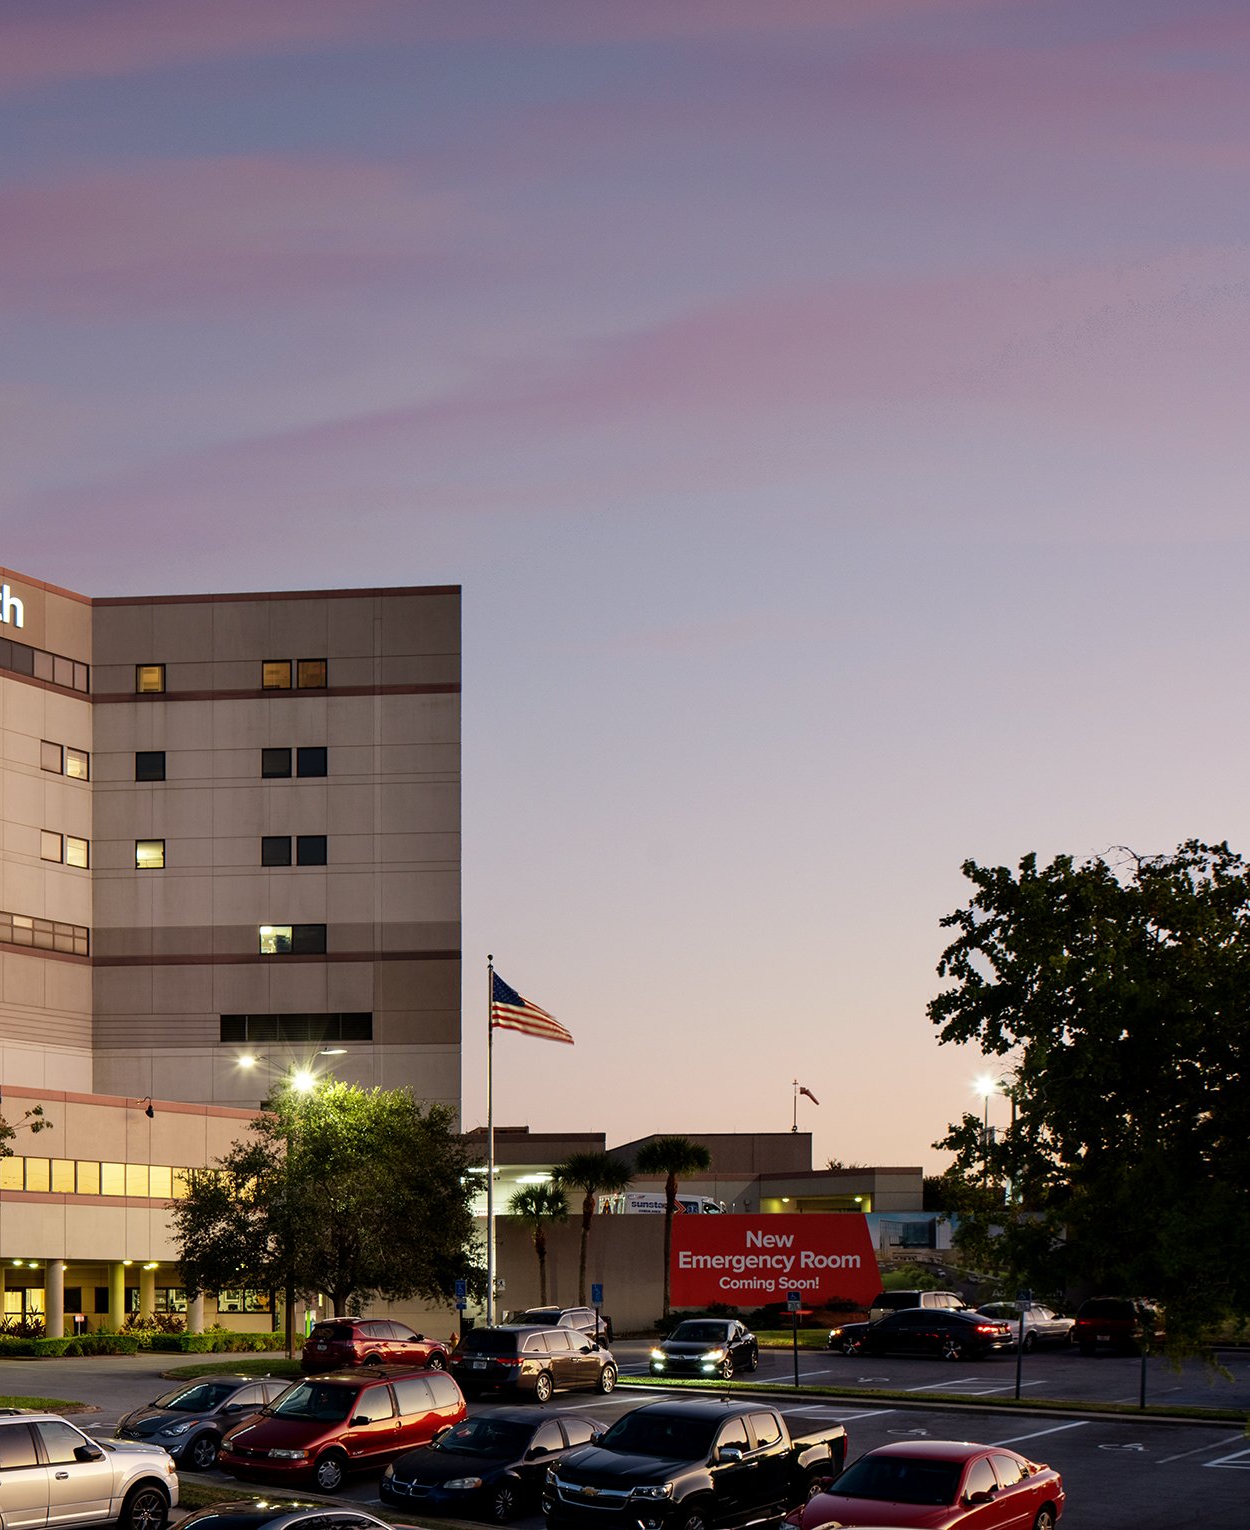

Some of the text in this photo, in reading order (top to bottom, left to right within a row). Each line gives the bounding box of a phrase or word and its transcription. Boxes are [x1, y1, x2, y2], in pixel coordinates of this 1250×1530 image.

[631, 1201, 668, 1209] sunsta
[746, 1230, 794, 1248] New
[678, 1251, 861, 1273] Emergency Room
[719, 1276, 820, 1292] Coming Soon!
